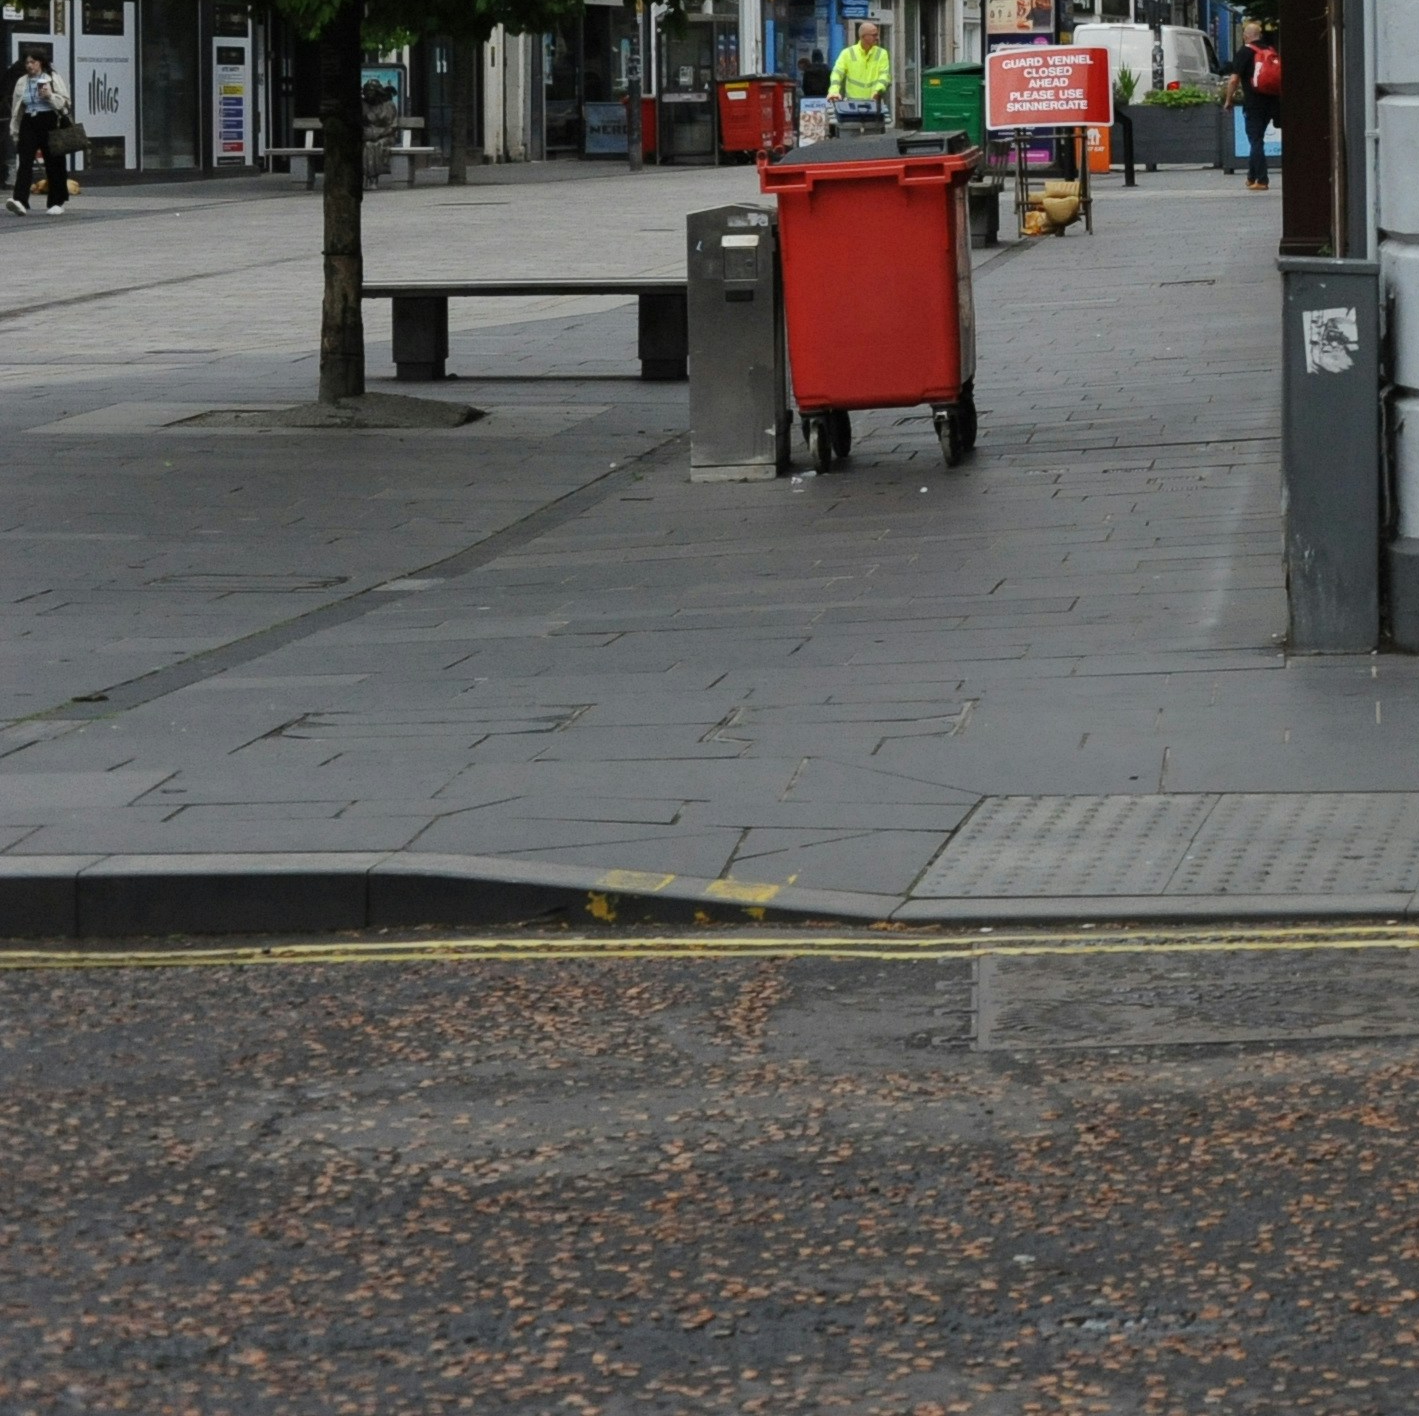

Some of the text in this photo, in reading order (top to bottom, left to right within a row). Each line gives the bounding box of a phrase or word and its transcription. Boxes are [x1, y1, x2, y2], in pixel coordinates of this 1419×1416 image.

[1002, 54, 1094, 69] GUARD VENNEL
[1023, 66, 1072, 78] CLOSED
[1028, 78, 1068, 88] AHEAD
[1010, 88, 1084, 101] PLEASE USE
[1006, 100, 1088, 112] SKINNERGATE
